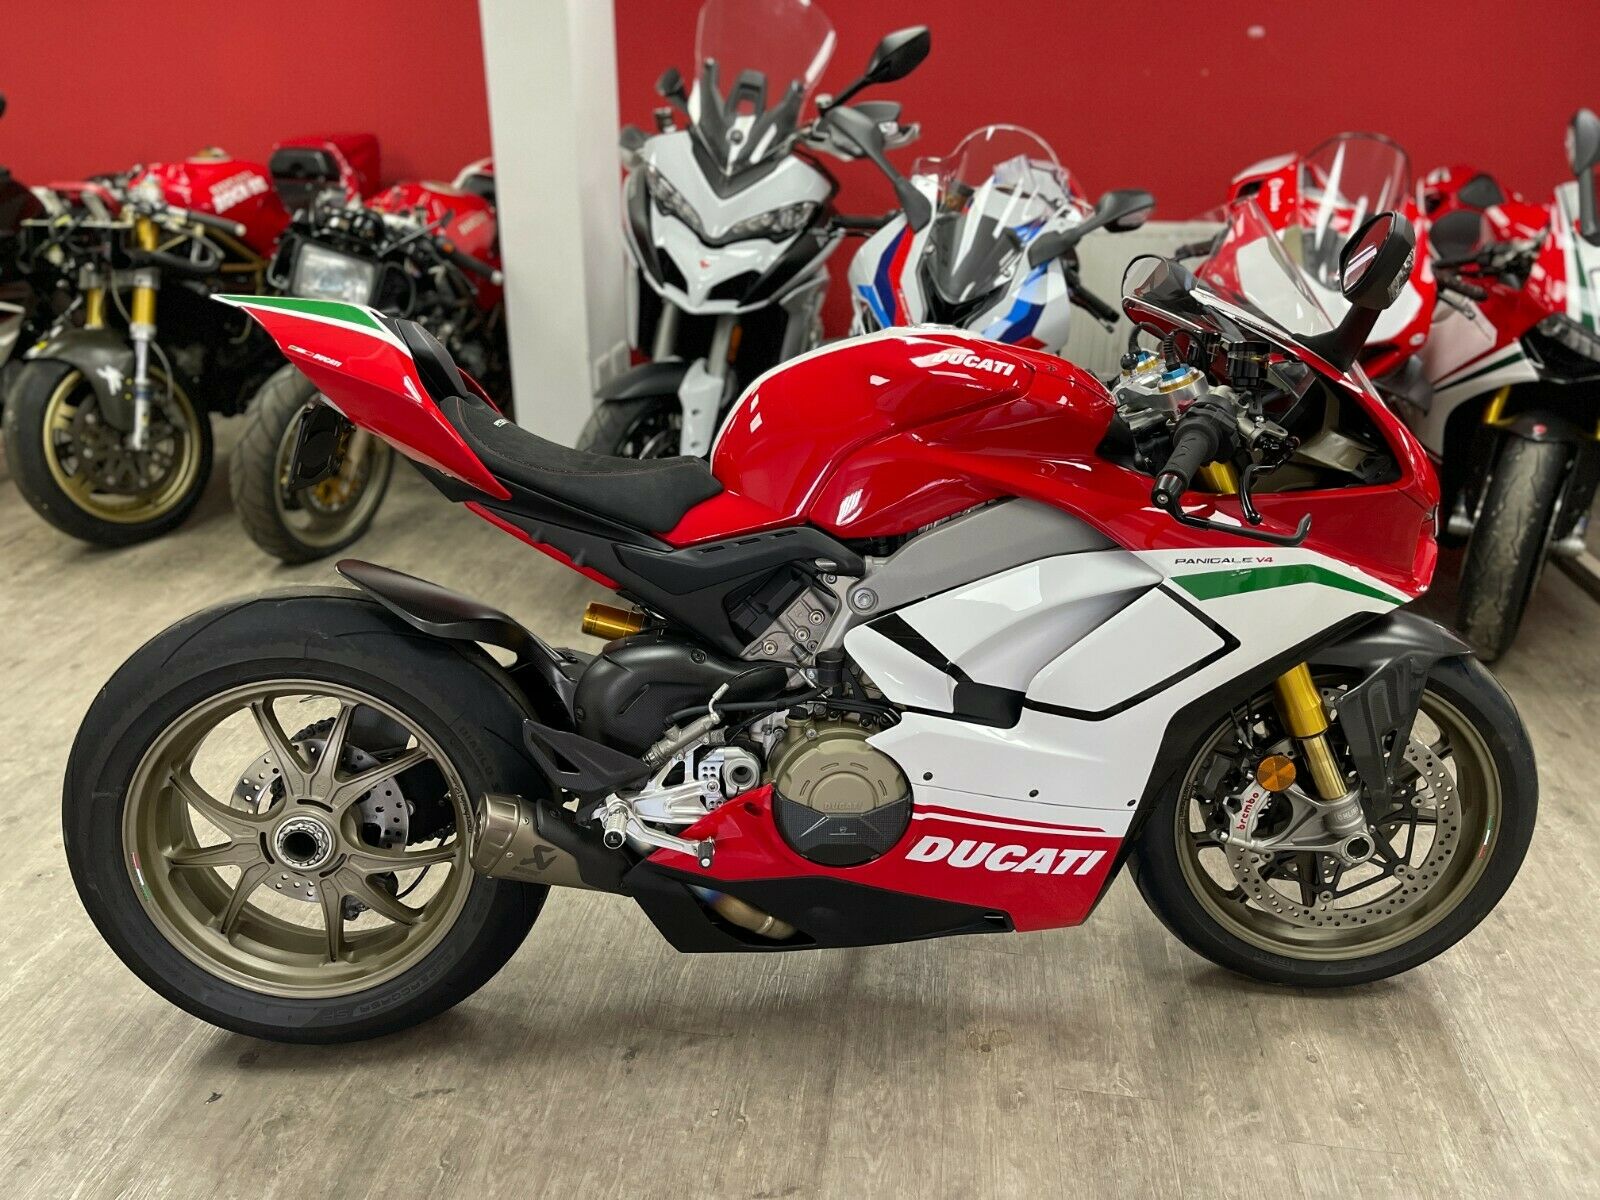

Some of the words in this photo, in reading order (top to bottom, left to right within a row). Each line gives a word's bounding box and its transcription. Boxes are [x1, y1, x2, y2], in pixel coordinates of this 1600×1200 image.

[931, 352, 1015, 376] DUCATI
[1175, 557, 1254, 565] PANIGALE
[823, 801, 865, 811] DUCATI
[1236, 792, 1260, 830] brembo
[905, 835, 1108, 876] DUCATI
